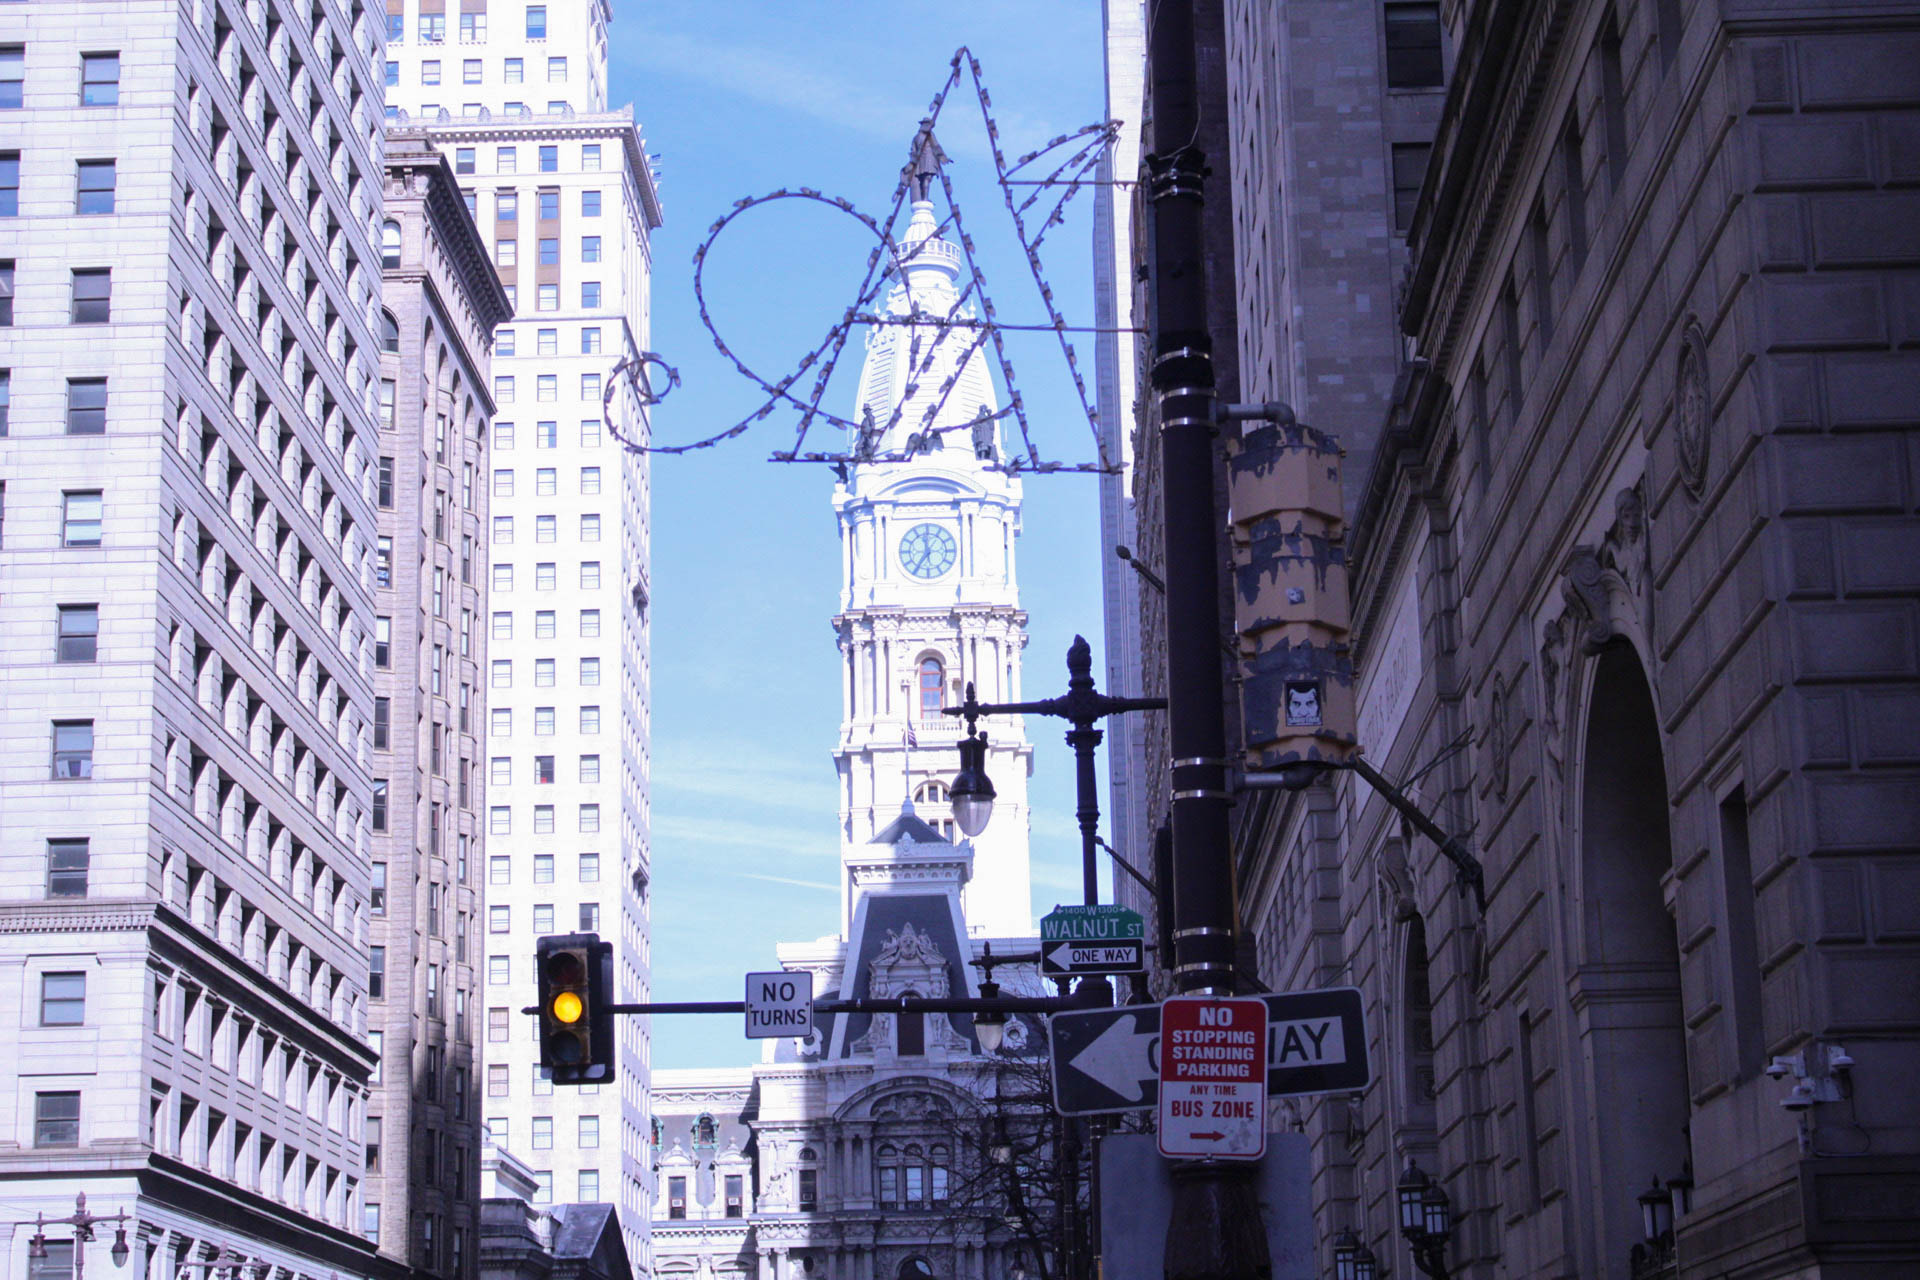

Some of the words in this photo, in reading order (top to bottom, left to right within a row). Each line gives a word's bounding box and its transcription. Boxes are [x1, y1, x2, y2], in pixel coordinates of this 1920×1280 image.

[1087, 906, 1097, 916] W
[1098, 906, 1118, 914] 1300
[1044, 918, 1119, 939] WALNUT
[1127, 923, 1141, 936] ST
[1072, 949, 1099, 962] ONE
[1104, 948, 1132, 961] WAY
[762, 982, 795, 1002] NO
[750, 1009, 806, 1026] TURNS
[1200, 1007, 1233, 1027] NO
[1172, 1030, 1256, 1044] STOPPING
[1268, 1022, 1330, 1064] AY
[1172, 1046, 1255, 1060] STANDING
[1177, 1063, 1250, 1077] PARKING
[1190, 1085, 1209, 1095] ANY
[1214, 1085, 1237, 1096] TIME
[1171, 1100, 1204, 1118] BUS
[1212, 1101, 1254, 1118] ZONE
